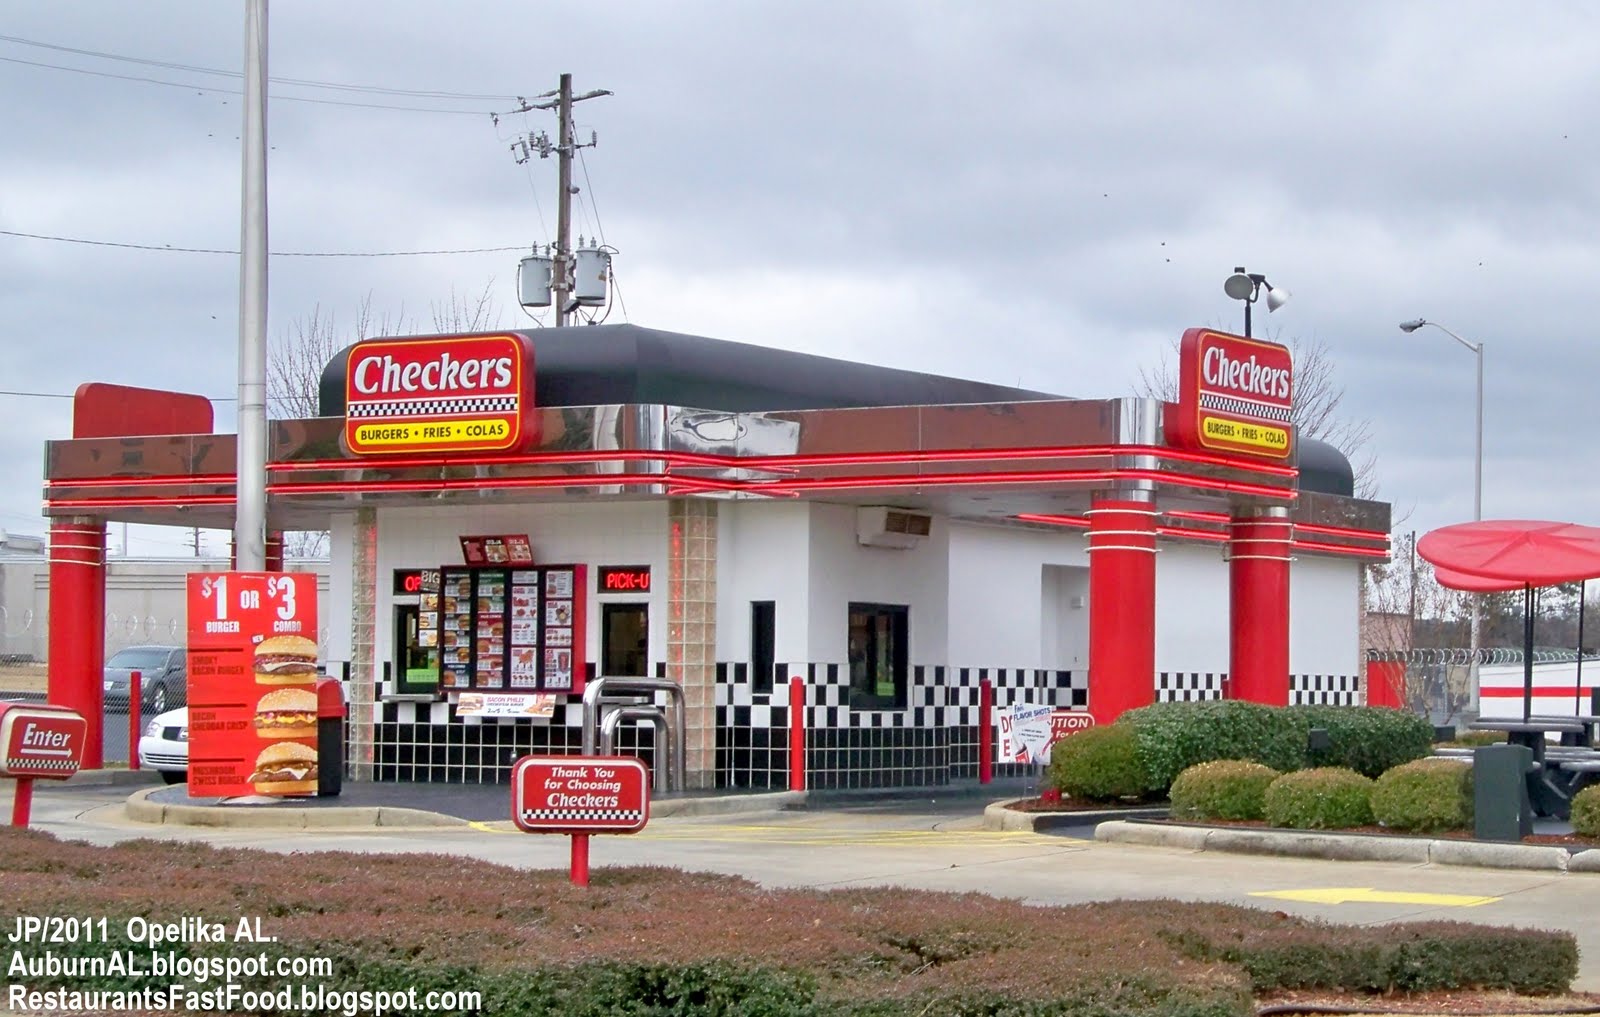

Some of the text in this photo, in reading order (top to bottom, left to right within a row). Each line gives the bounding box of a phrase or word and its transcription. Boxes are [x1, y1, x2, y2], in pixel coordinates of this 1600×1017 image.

[354, 352, 512, 394] Checkers
[1203, 346, 1290, 399] Checkers
[360, 424, 504, 441] BURGERS FRIES COLAS
[1207, 421, 1285, 444] BURGERS FRIES COLAS
[421, 570, 440, 584] BIG
[201, 575, 296, 621] $1 OR $3
[206, 620, 302, 633] BURGER COMBO
[191, 665, 244, 675] BACON BURGER
[1014, 711, 1033, 721] FLAVOR
[1034, 706, 1051, 717] SHOTS
[191, 720, 248, 731] CHEDDAR CRISP
[22, 722, 72, 747] Enter
[192, 766, 236, 776] MUSHROOM
[551, 767, 615, 778] Thank You
[192, 775, 245, 785] SWISS BURGER
[544, 778, 621, 792] for Choosing
[547, 792, 619, 807] Checkers
